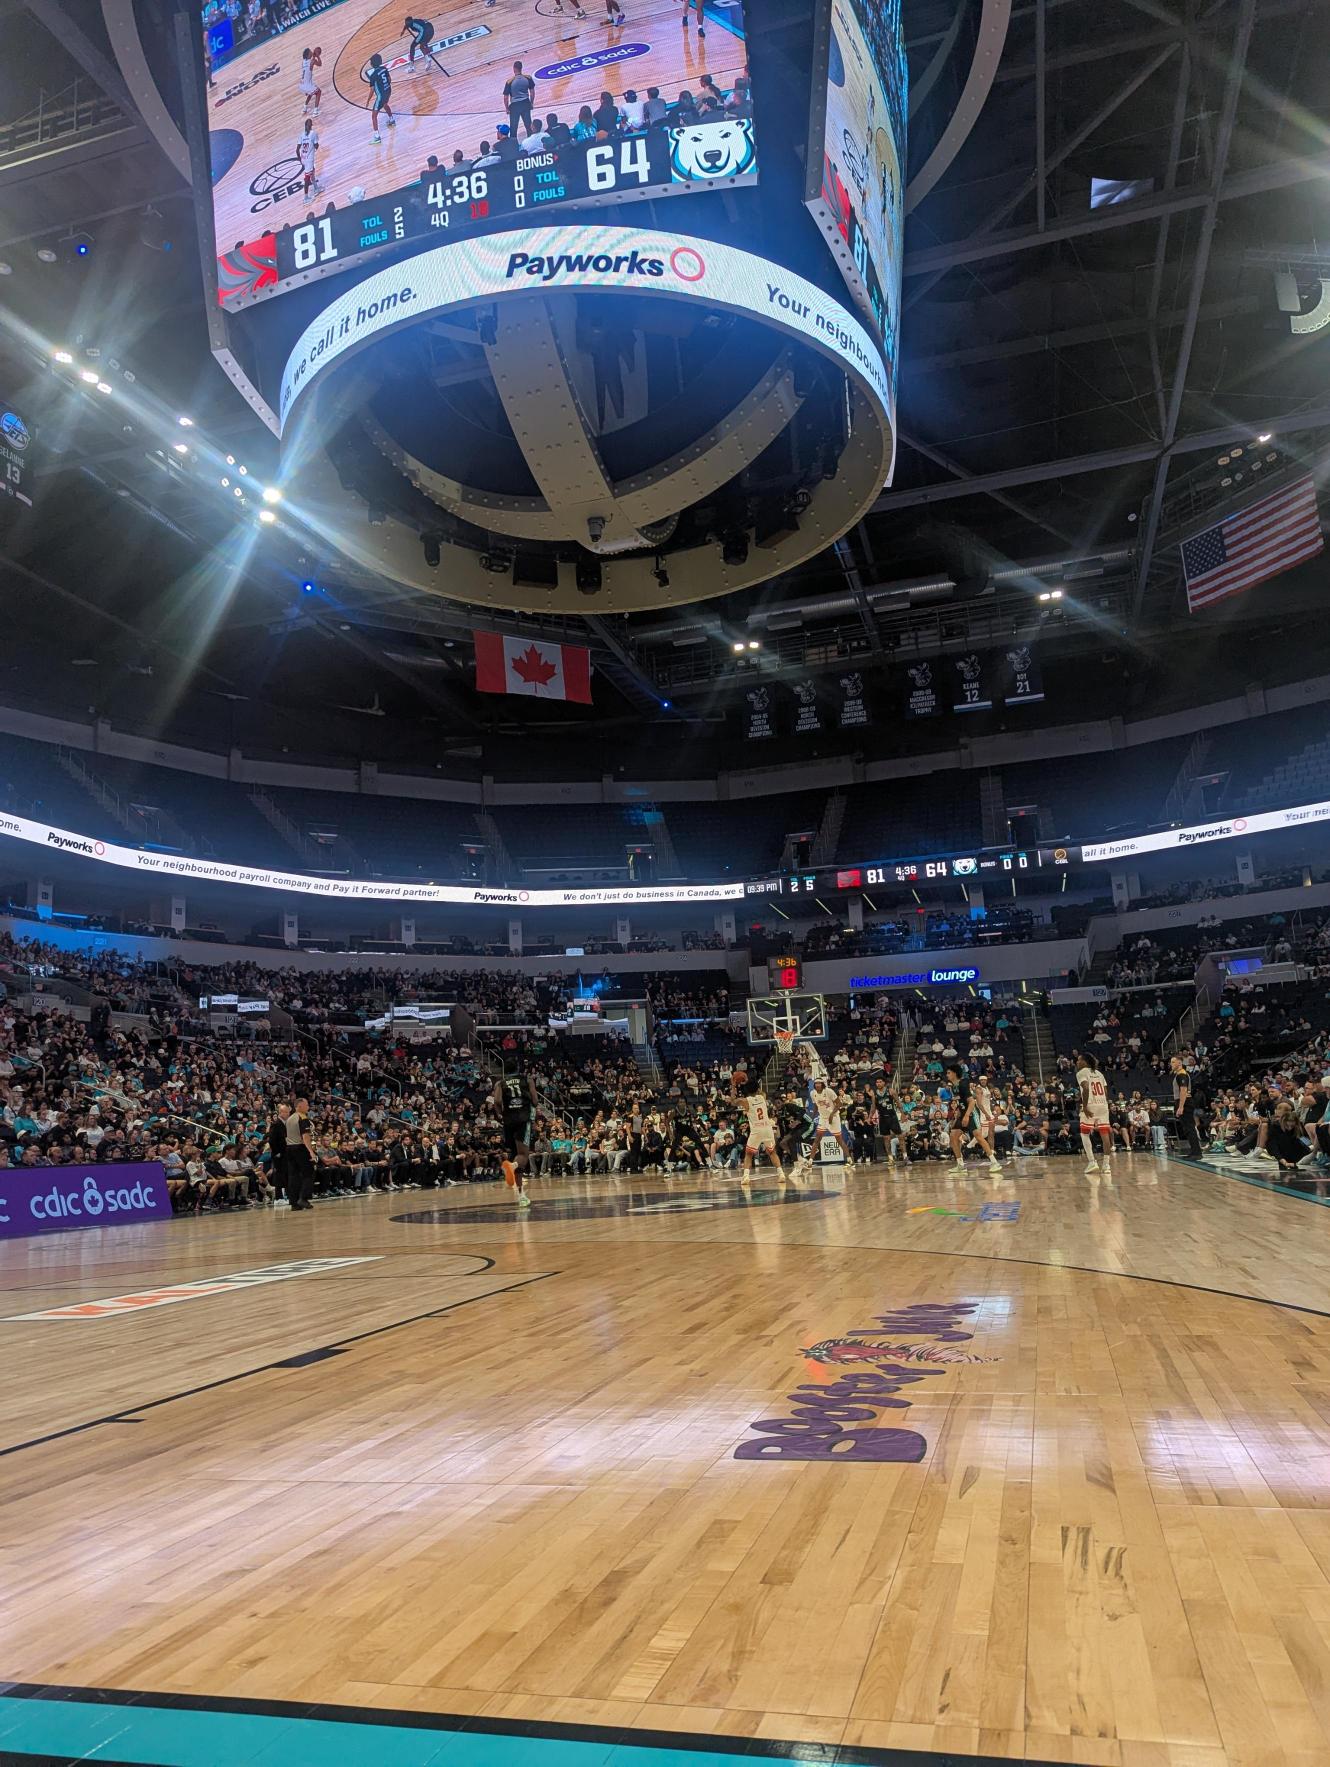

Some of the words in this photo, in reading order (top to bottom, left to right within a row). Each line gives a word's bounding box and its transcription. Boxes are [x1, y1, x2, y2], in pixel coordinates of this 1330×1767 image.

[516, 153, 554, 172] BONUS
[586, 139, 651, 191] 64
[427, 171, 488, 209] 4:36
[514, 175, 524, 193] 0
[536, 171, 559, 184] TOL
[250, 180, 306, 214] CEB
[515, 192, 526, 209] 0
[533, 186, 565, 202] FOULS
[362, 215, 383, 229] TOL
[394, 206, 404, 223] 2
[431, 211, 449, 227] 4Q
[293, 217, 338, 270] 81
[360, 230, 388, 247] FOULS
[395, 223, 405, 239] 5
[505, 250, 665, 281] Payworks
[767, 283, 811, 318] Your
[294, 358, 307, 385] we
[310, 326, 334, 363] call
[339, 315, 351, 338] it
[356, 287, 417, 326] home.
[6, 462, 21, 485] 13
[965, 689, 980, 702] 12
[1016, 681, 1031, 693] 21
[47, 831, 93, 854] Payworks
[1178, 825, 1232, 842] Payworks
[1099, 847, 1107, 855] it
[1109, 843, 1139, 854] home.
[137, 855, 160, 867] Your
[163, 861, 237, 878] neighbourhood
[239, 870, 270, 884] payroll
[272, 876, 312, 890] company
[313, 882, 330, 891] and
[332, 884, 350, 894] Pay
[352, 885, 359, 893] it
[361, 886, 401, 896] Forward
[402, 888, 440, 898] partner!
[790, 881, 799, 892] 2
[805, 879, 814, 891] 5
[866, 868, 885, 884] 81
[895, 866, 917, 875] 4:36
[925, 861, 947, 877] 64
[1003, 858, 1012, 870] 0
[1019, 856, 1028, 868] 0
[473, 892, 518, 902] Payworks
[563, 893, 577, 901] We
[579, 892, 602, 901] don't
[603, 892, 620, 901] just
[622, 891, 634, 899] do
[636, 890, 675, 899] business
[676, 889, 685, 897] in
[687, 889, 722, 898] Canada,
[777, 957, 797, 967] 4:36
[850, 973, 926, 988] ticketmaster
[931, 969, 976, 982] lounge
[1090, 1081, 1105, 1096] 30
[756, 1107, 764, 1120] 2
[823, 1141, 840, 1149] NEW
[824, 1148, 841, 1156] ERA
[30, 1186, 82, 1219] cdic
[104, 1180, 157, 1212] sadc
[189, 1259, 357, 1287] TIRE
[733, 1363, 946, 1463] Booster
